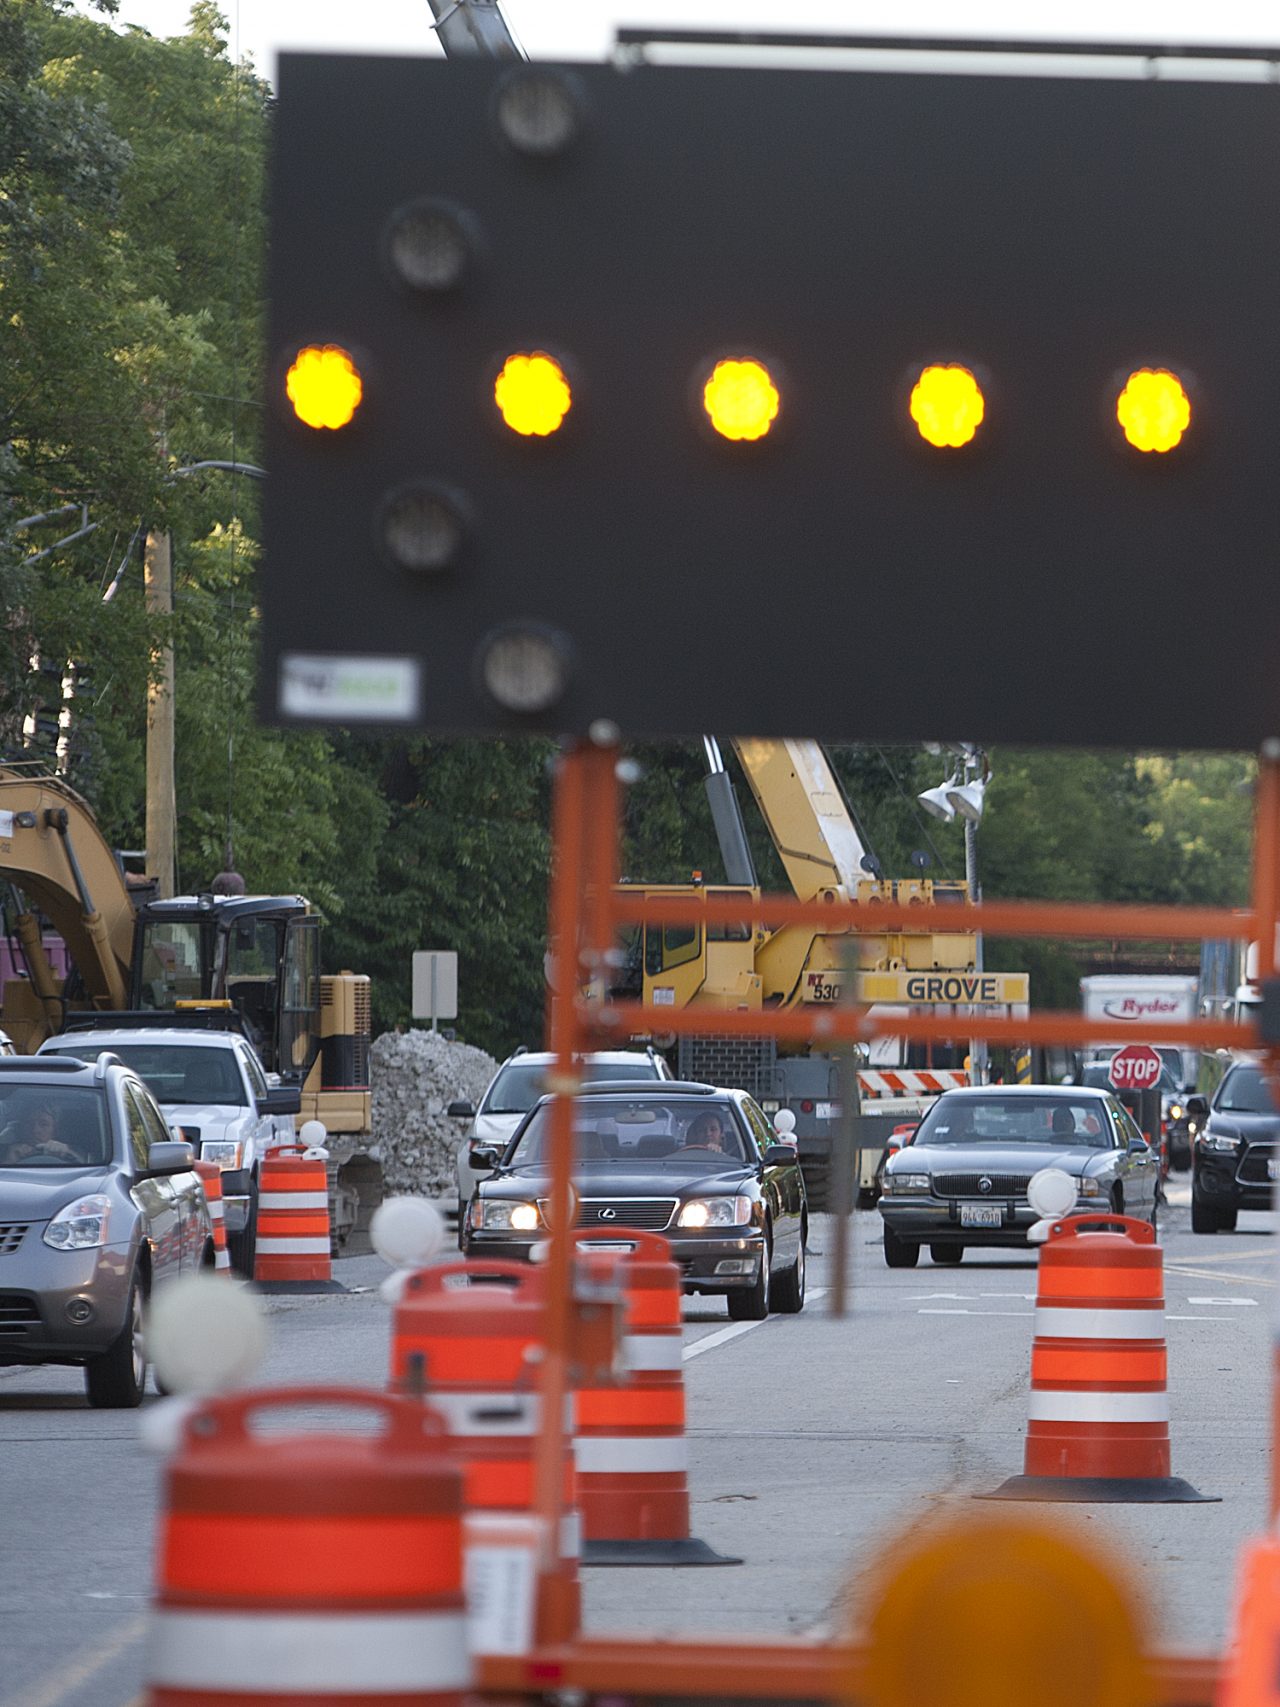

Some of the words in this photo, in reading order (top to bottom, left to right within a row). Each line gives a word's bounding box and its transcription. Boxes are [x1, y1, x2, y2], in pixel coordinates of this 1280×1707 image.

[807, 974, 824, 986] RT
[906, 978, 996, 1001] GROVE
[1123, 998, 1178, 1014] Ryder
[1113, 1058, 1158, 1080] STOP
